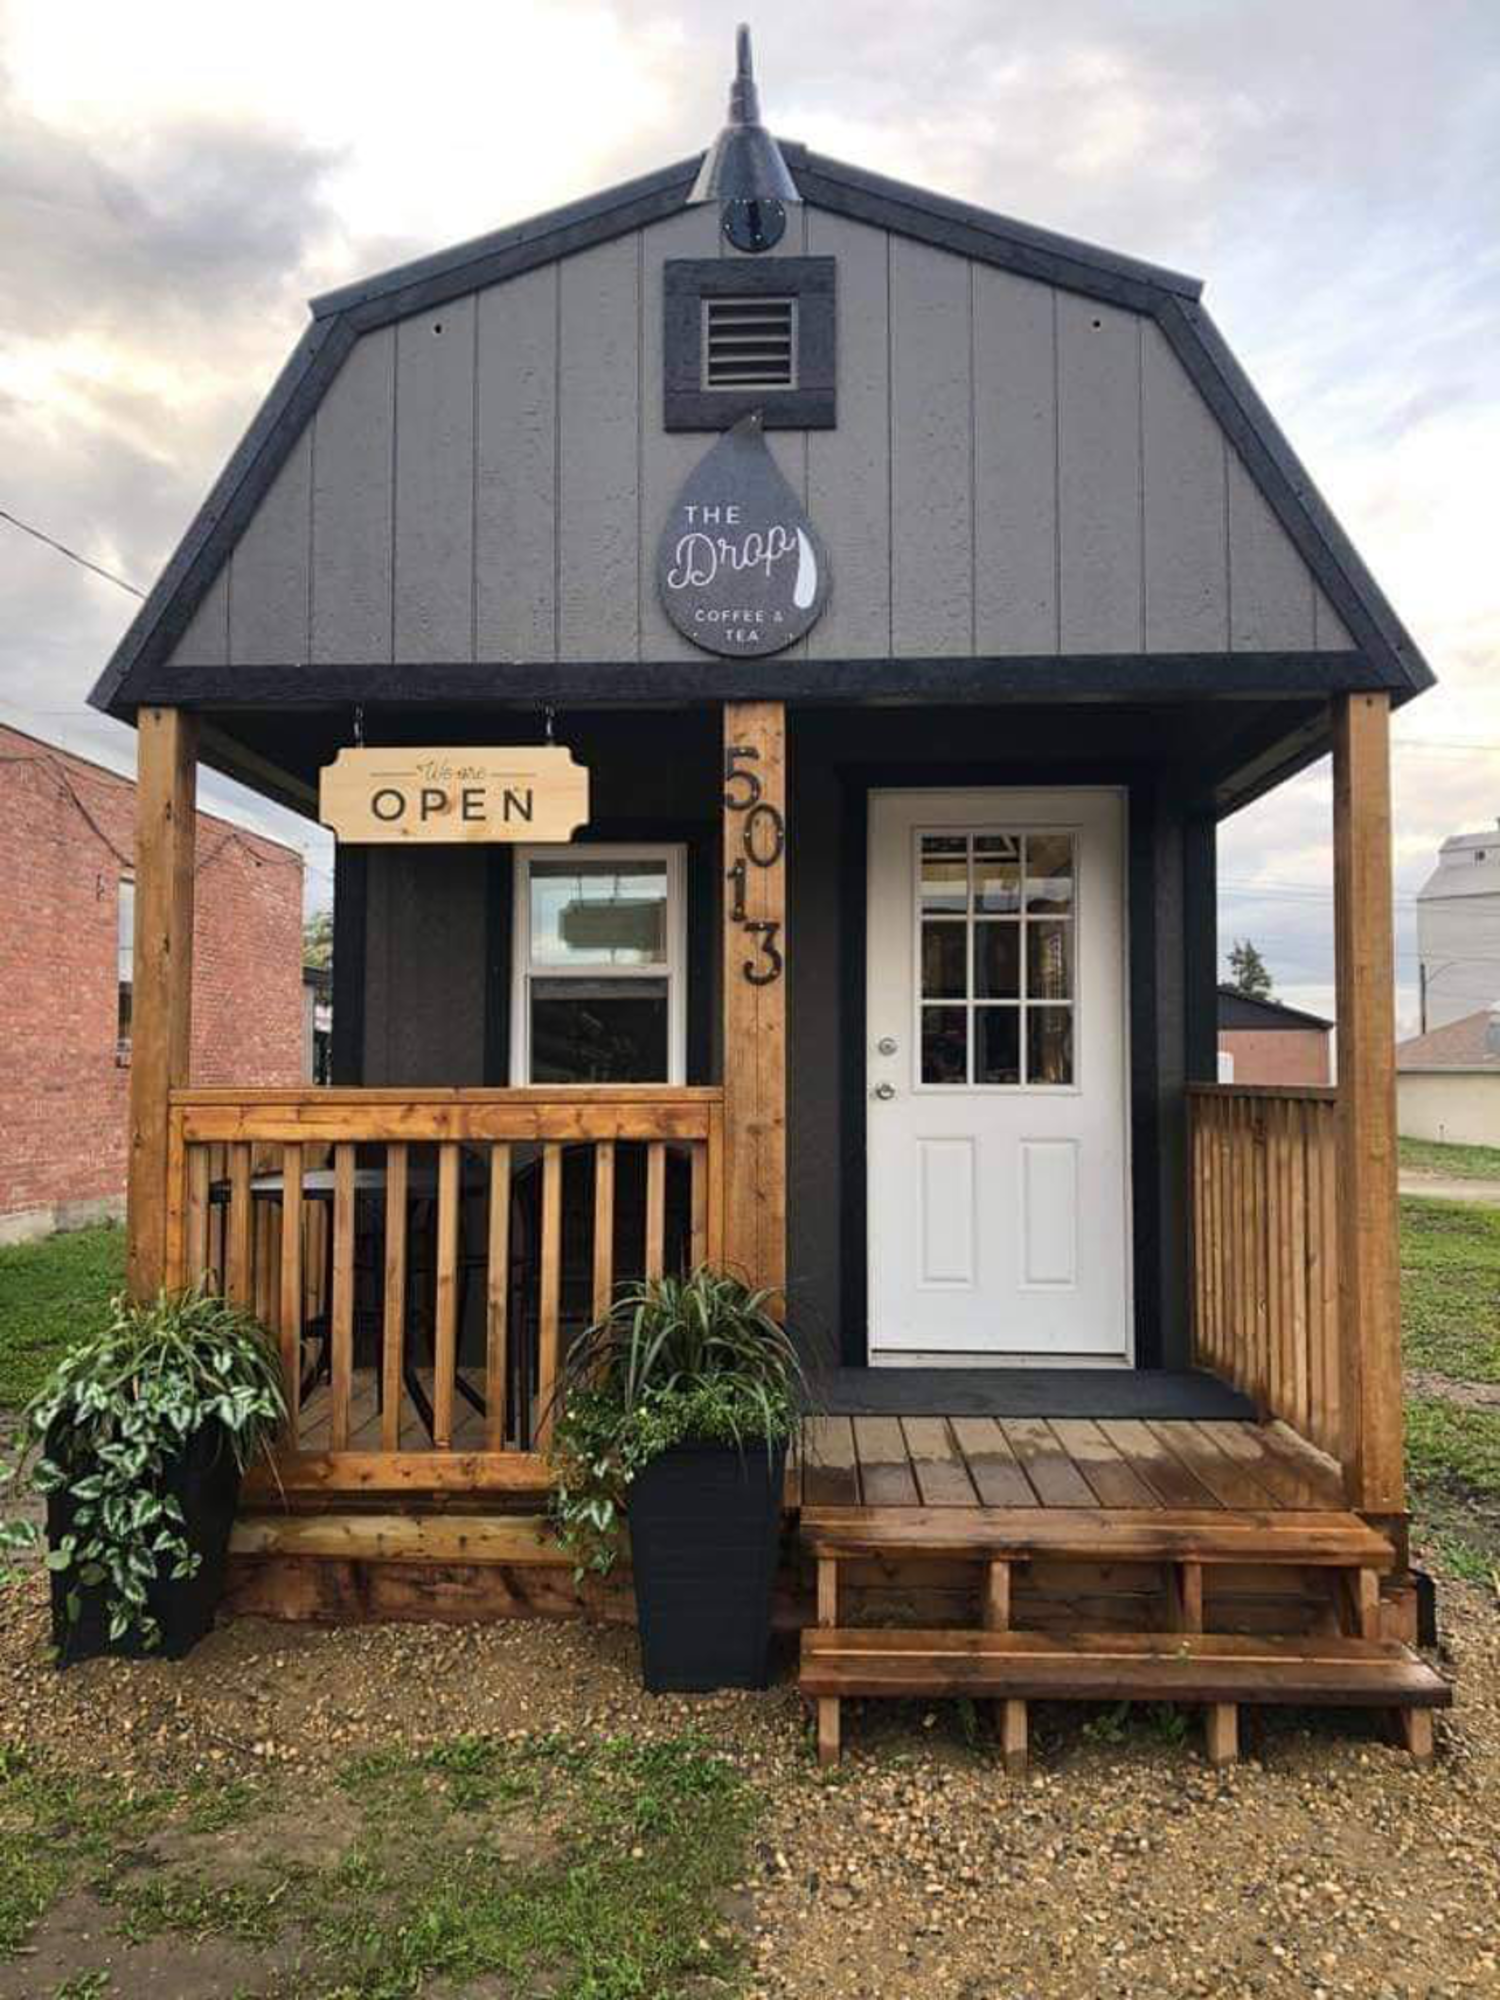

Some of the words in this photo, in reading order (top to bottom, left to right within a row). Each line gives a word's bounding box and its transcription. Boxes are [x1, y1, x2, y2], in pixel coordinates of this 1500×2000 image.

[684, 505, 741, 524] THE
[667, 525, 797, 589] Drop
[694, 610, 765, 622] COFFEE
[773, 611, 784, 622] &
[725, 629, 760, 642] TEA
[416, 760, 452, 781] We
[456, 765, 487, 780] are
[371, 788, 534, 823] OPEN
